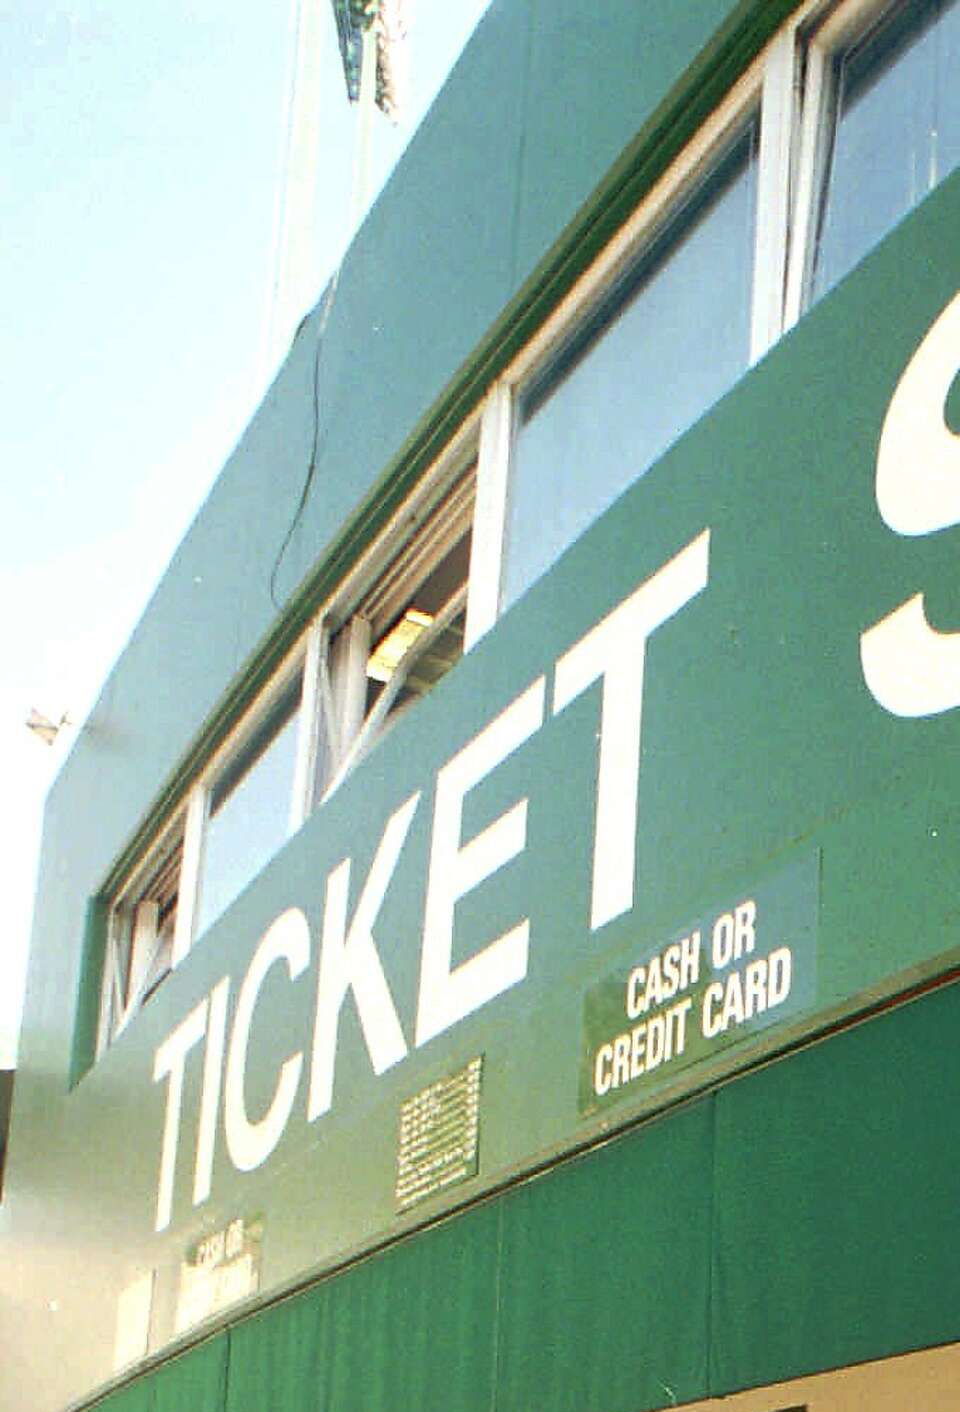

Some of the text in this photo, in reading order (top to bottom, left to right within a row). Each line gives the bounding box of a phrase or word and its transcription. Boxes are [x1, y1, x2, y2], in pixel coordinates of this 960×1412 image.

[153, 528, 710, 1232] TICKET
[594, 947, 791, 1096] CREDIT CARD
[627, 899, 756, 1019] CASH OR
